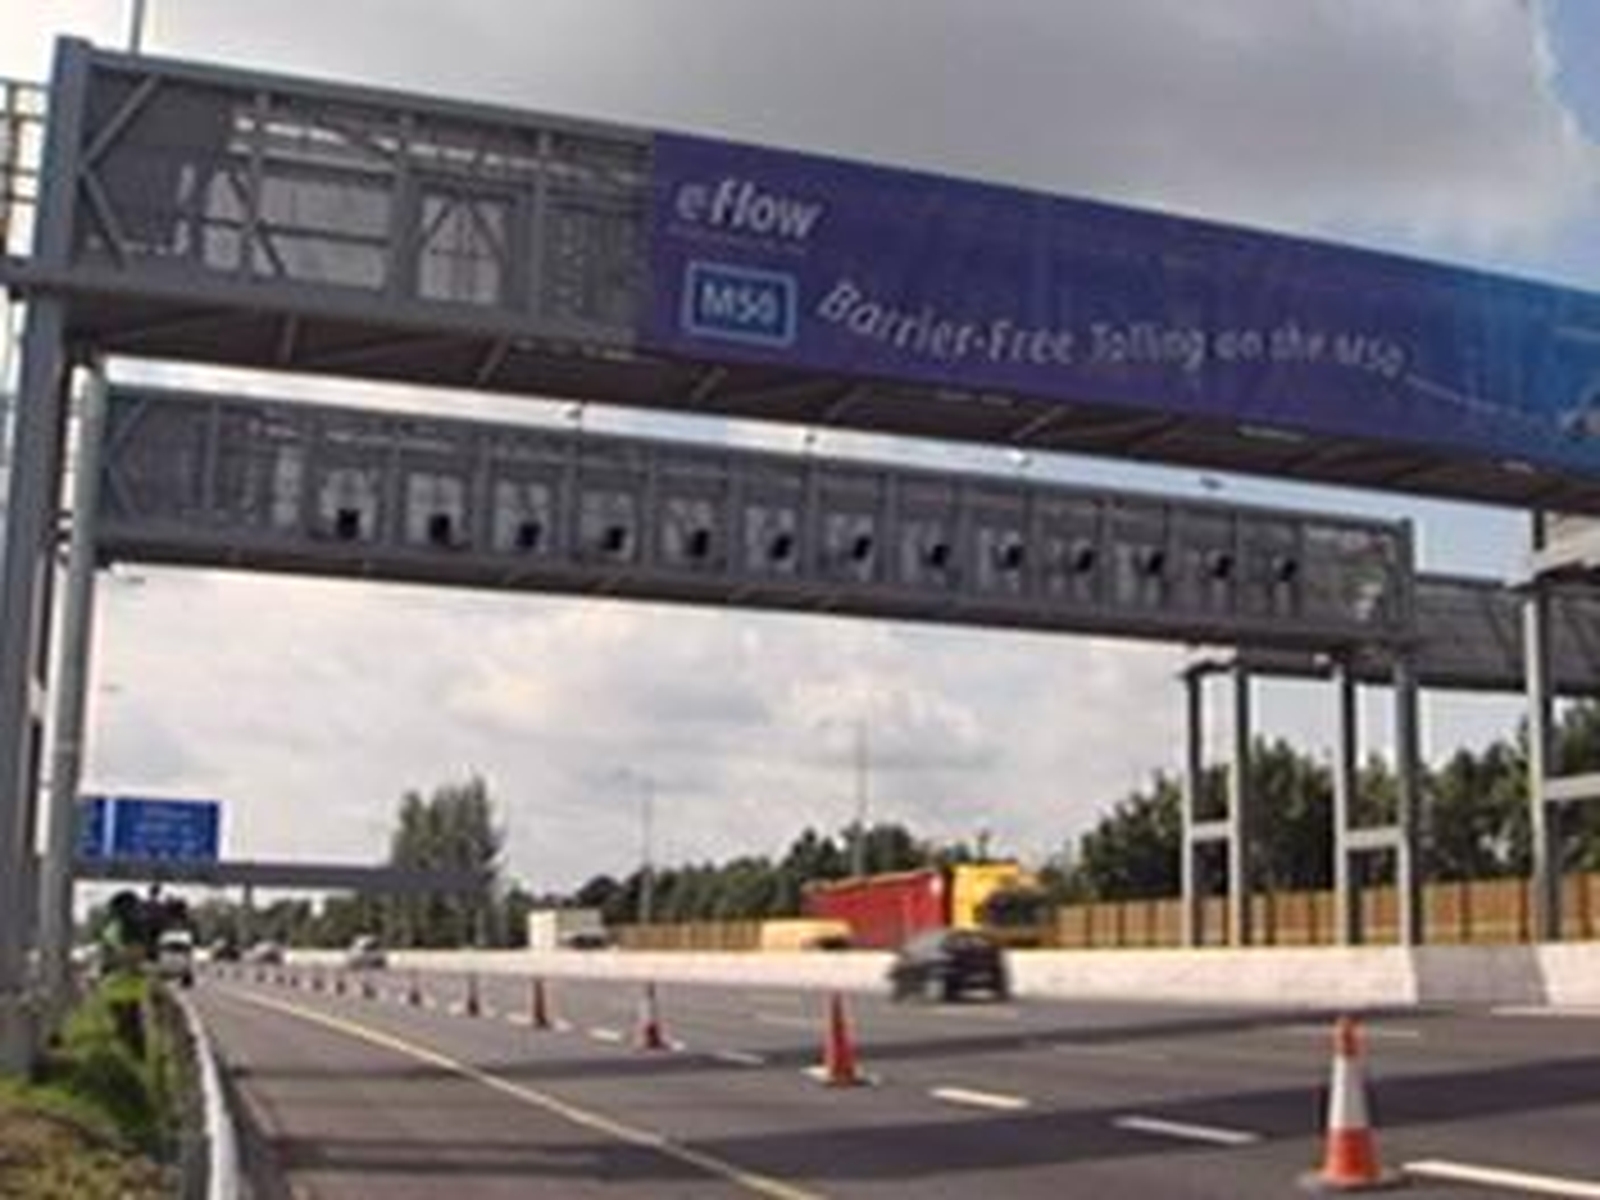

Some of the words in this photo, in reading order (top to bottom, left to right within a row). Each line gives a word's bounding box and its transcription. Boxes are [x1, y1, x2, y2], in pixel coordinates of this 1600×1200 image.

[676, 178, 823, 239] eflow
[699, 281, 780, 327] M50
[816, 277, 1075, 365] Barrier-Free
[1090, 322, 1206, 372] Tolling
[1213, 329, 1263, 363] on
[1268, 318, 1326, 364] the
[1335, 332, 1404, 379] M50
